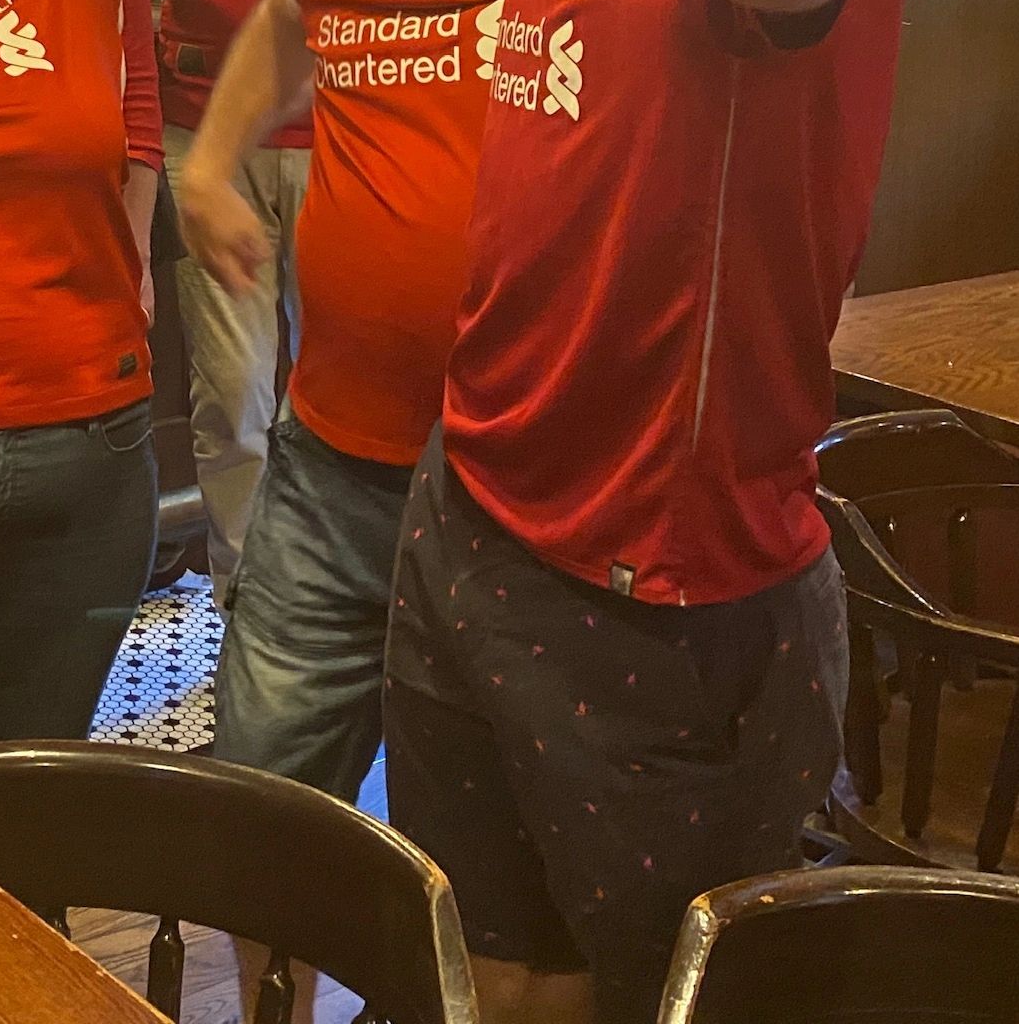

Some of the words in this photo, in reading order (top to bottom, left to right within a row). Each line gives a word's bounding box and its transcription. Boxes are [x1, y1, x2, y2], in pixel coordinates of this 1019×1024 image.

[318, 8, 461, 48] Standard
[496, 11, 547, 57] ndard
[316, 46, 461, 90] Chartered
[491, 62, 541, 111] tered
